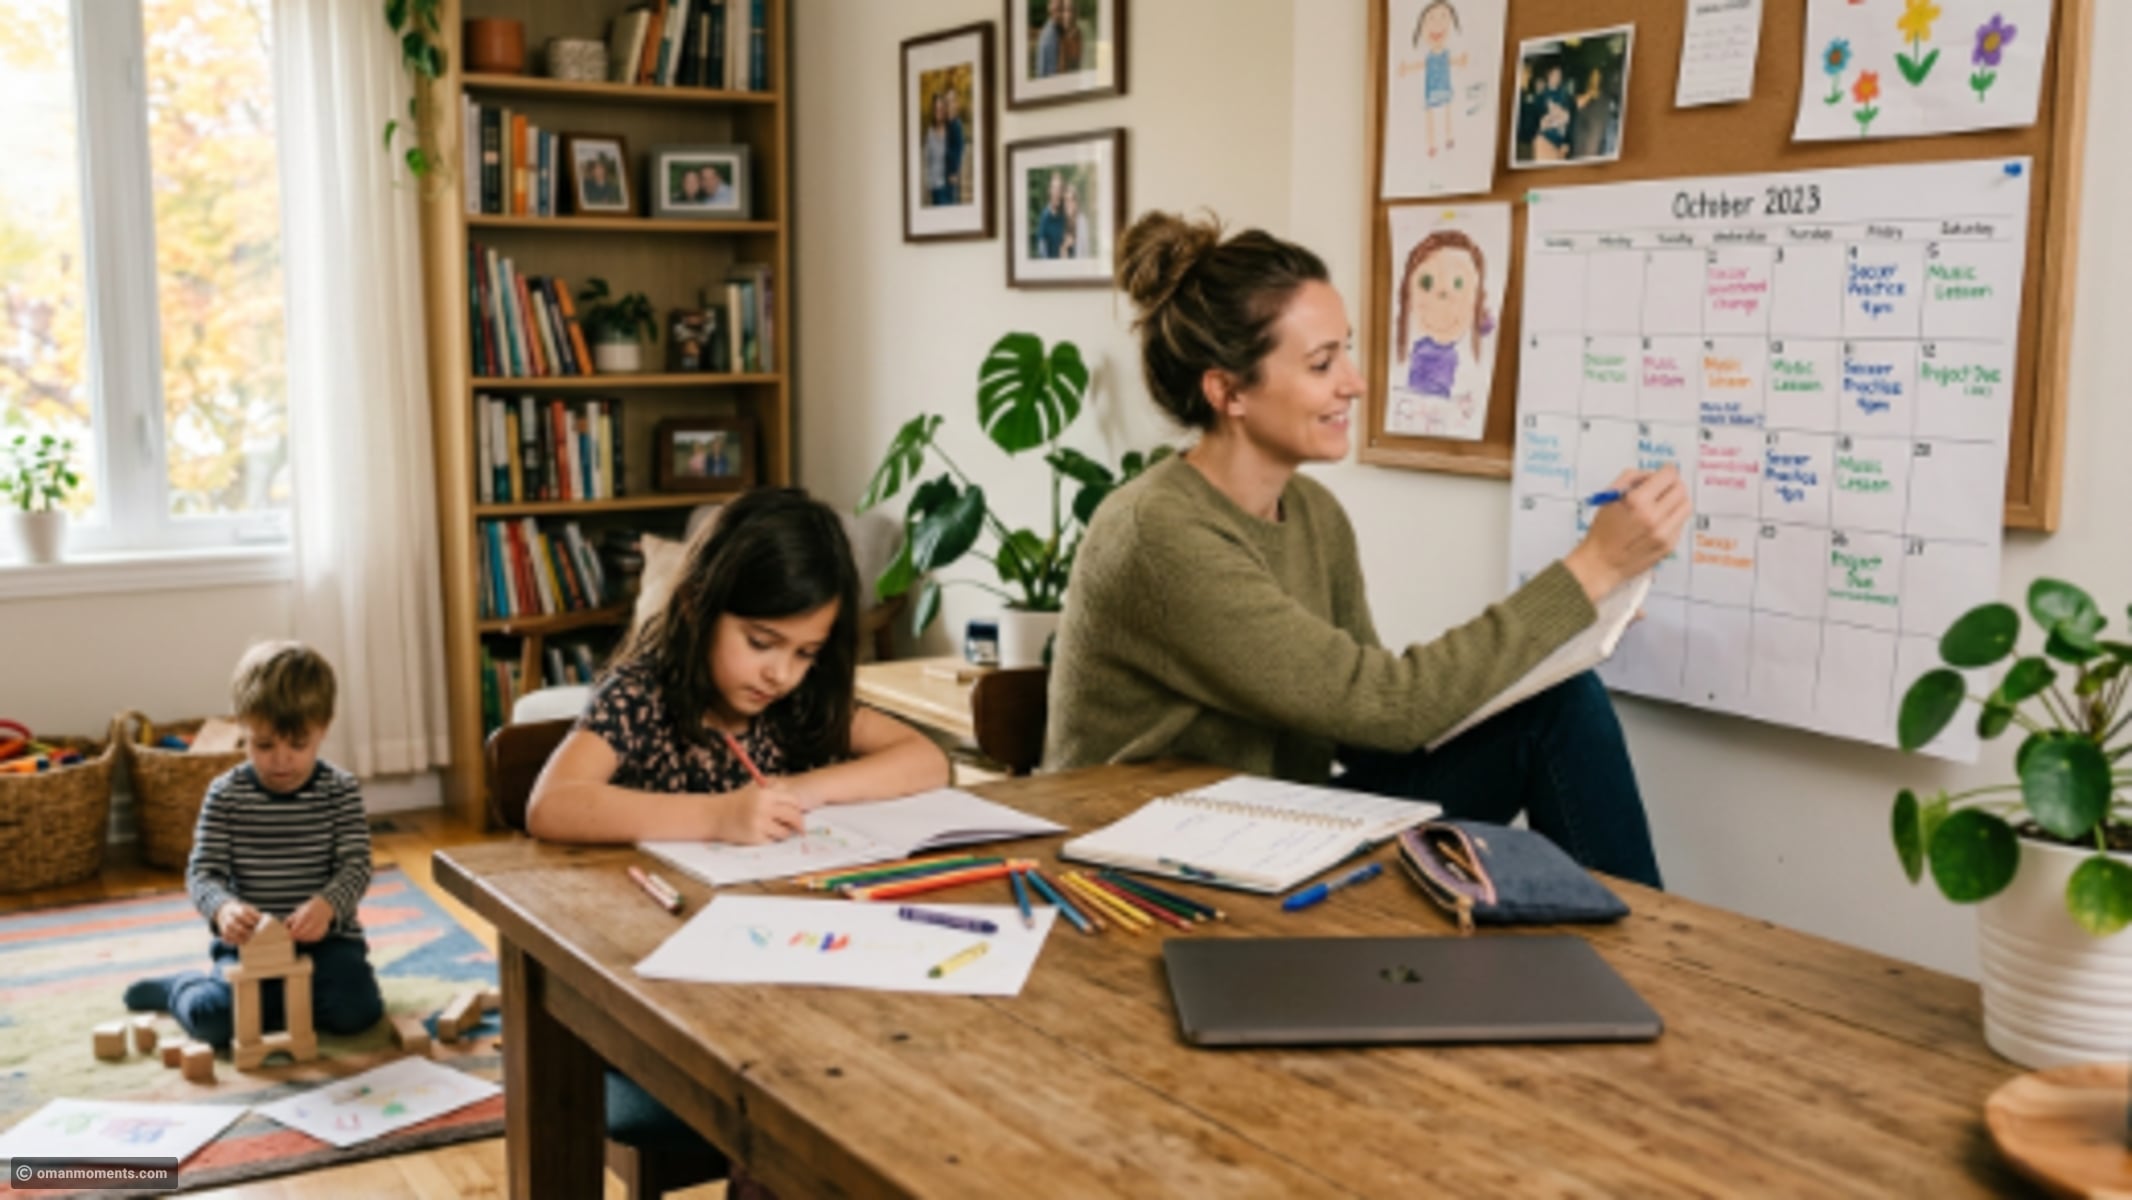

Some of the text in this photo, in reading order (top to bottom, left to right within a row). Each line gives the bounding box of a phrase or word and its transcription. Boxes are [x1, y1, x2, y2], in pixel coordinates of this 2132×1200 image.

[1672, 185, 1822, 219] October 2023
[1941, 220, 1995, 239] Saturday
[1927, 263, 1977, 281] Music
[1934, 283, 1994, 300] Lesson
[1921, 361, 1970, 387] Project
